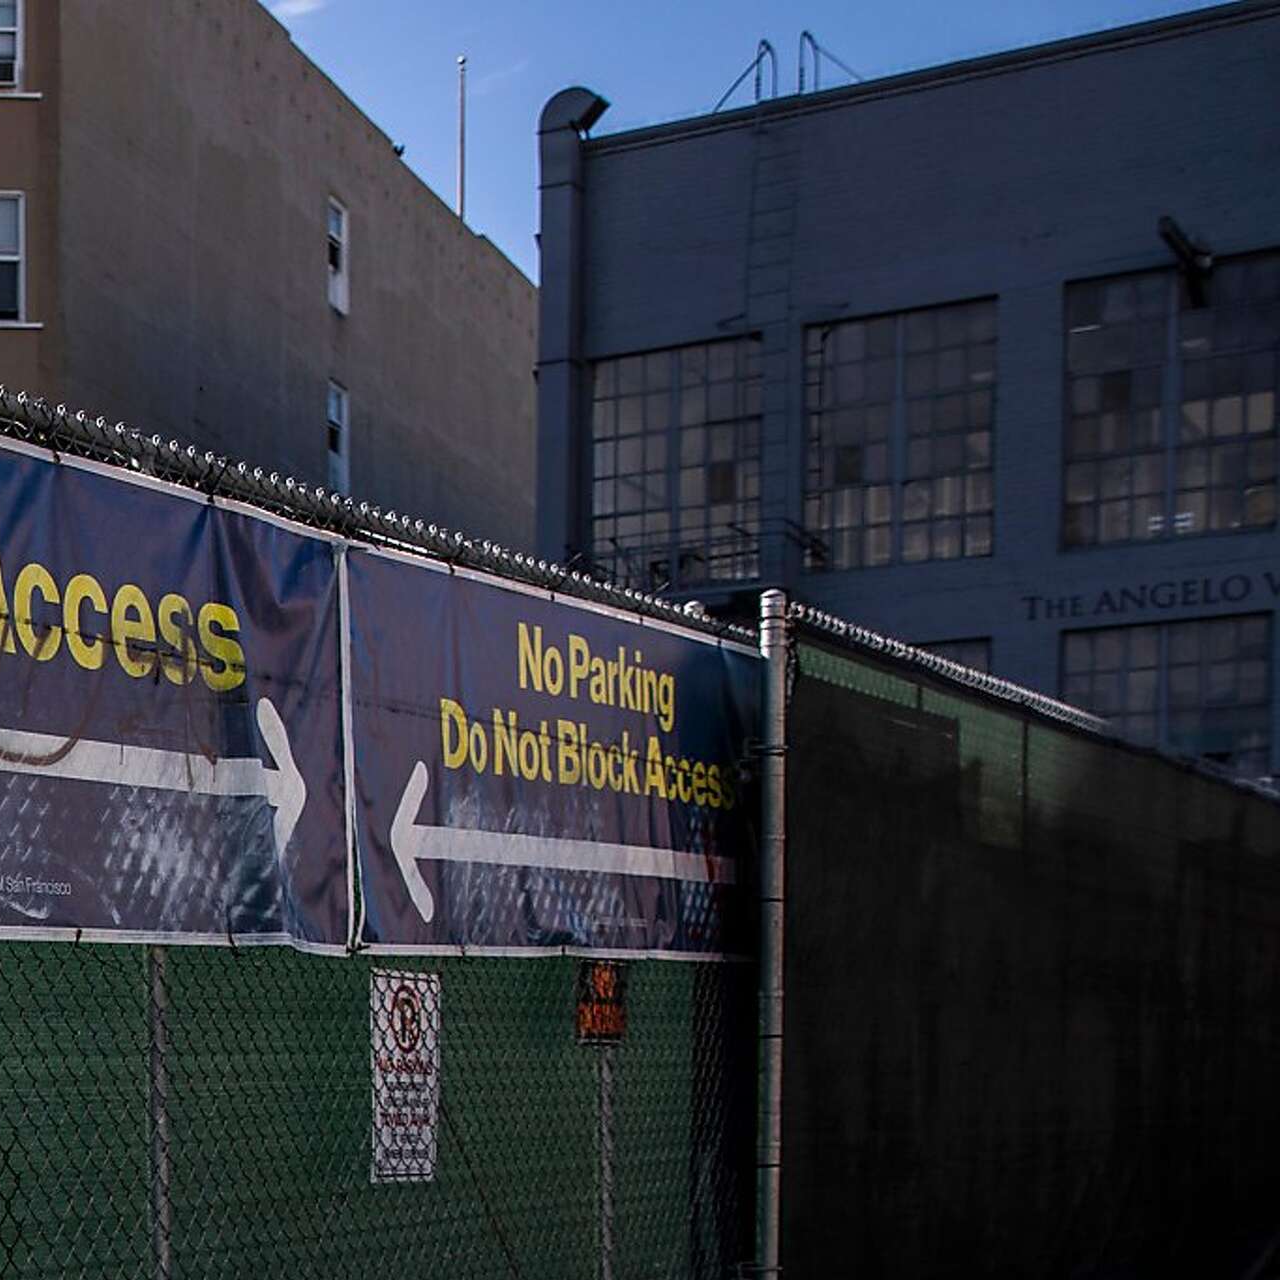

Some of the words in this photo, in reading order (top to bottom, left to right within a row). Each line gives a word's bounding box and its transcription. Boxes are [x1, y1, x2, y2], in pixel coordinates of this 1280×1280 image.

[1020, 595, 1084, 620] THE
[1093, 574, 1251, 615] ANGELO
[518, 622, 564, 696] No
[569, 634, 676, 733] Parking
[440, 697, 487, 775] Do
[493, 709, 552, 784] Not
[557, 719, 639, 795] Block
[644, 735, 737, 811] Access
